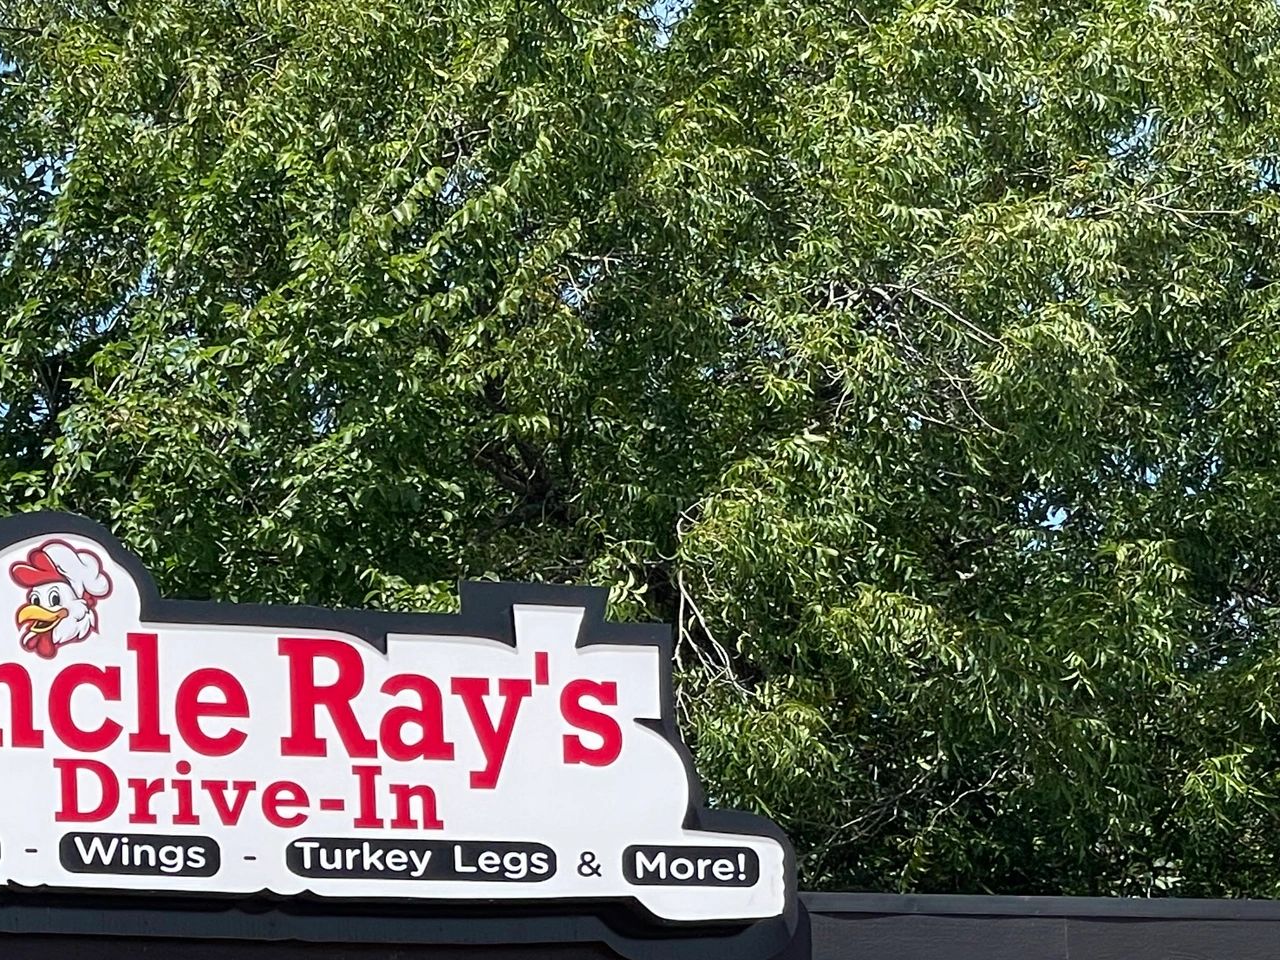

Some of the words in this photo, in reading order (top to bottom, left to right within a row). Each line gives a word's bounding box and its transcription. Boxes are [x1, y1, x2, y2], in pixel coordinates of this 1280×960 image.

[278, 637, 622, 789] Ray's
[53, 758, 444, 831] Drive-In
[73, 836, 206, 870] Wings
[294, 841, 432, 877] Turkey
[454, 845, 550, 880] Legs
[577, 851, 602, 878] &
[635, 852, 748, 881] More!
